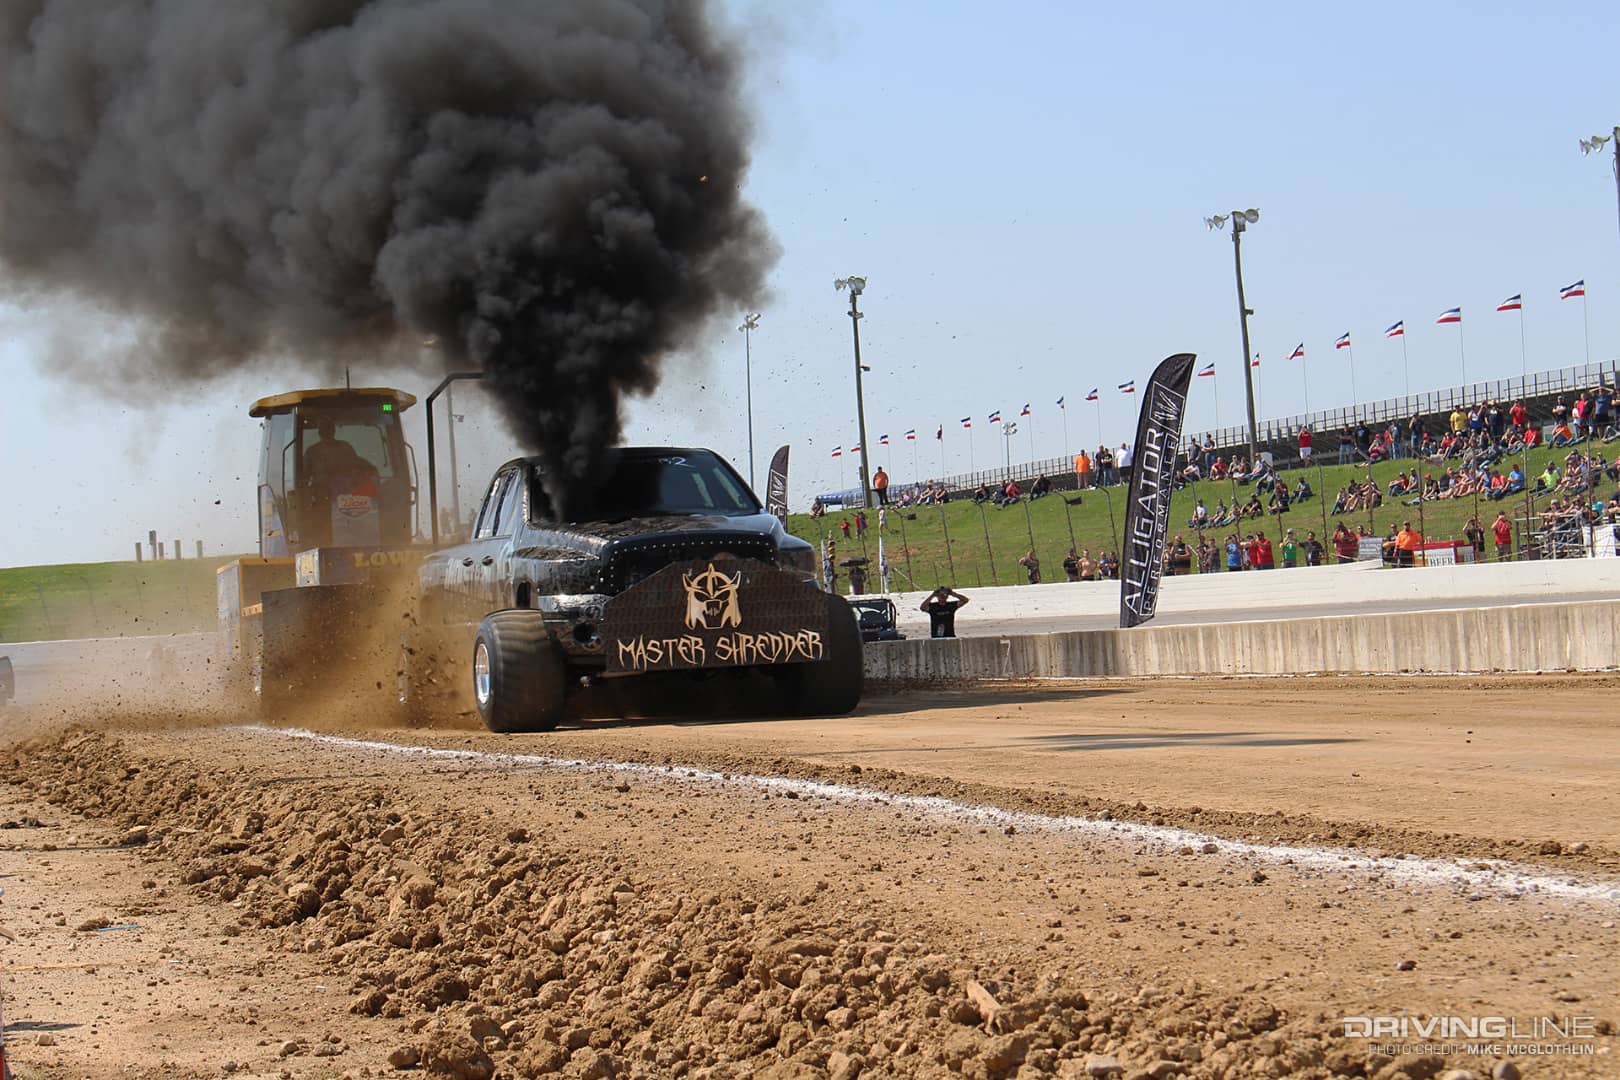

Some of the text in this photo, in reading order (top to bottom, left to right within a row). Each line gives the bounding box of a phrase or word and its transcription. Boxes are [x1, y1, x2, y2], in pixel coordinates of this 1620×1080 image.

[1125, 428, 1164, 615] ALLIGATOR
[1143, 440, 1176, 612] PERFORMANCE
[617, 628, 823, 671] MASTER SHREDDER
